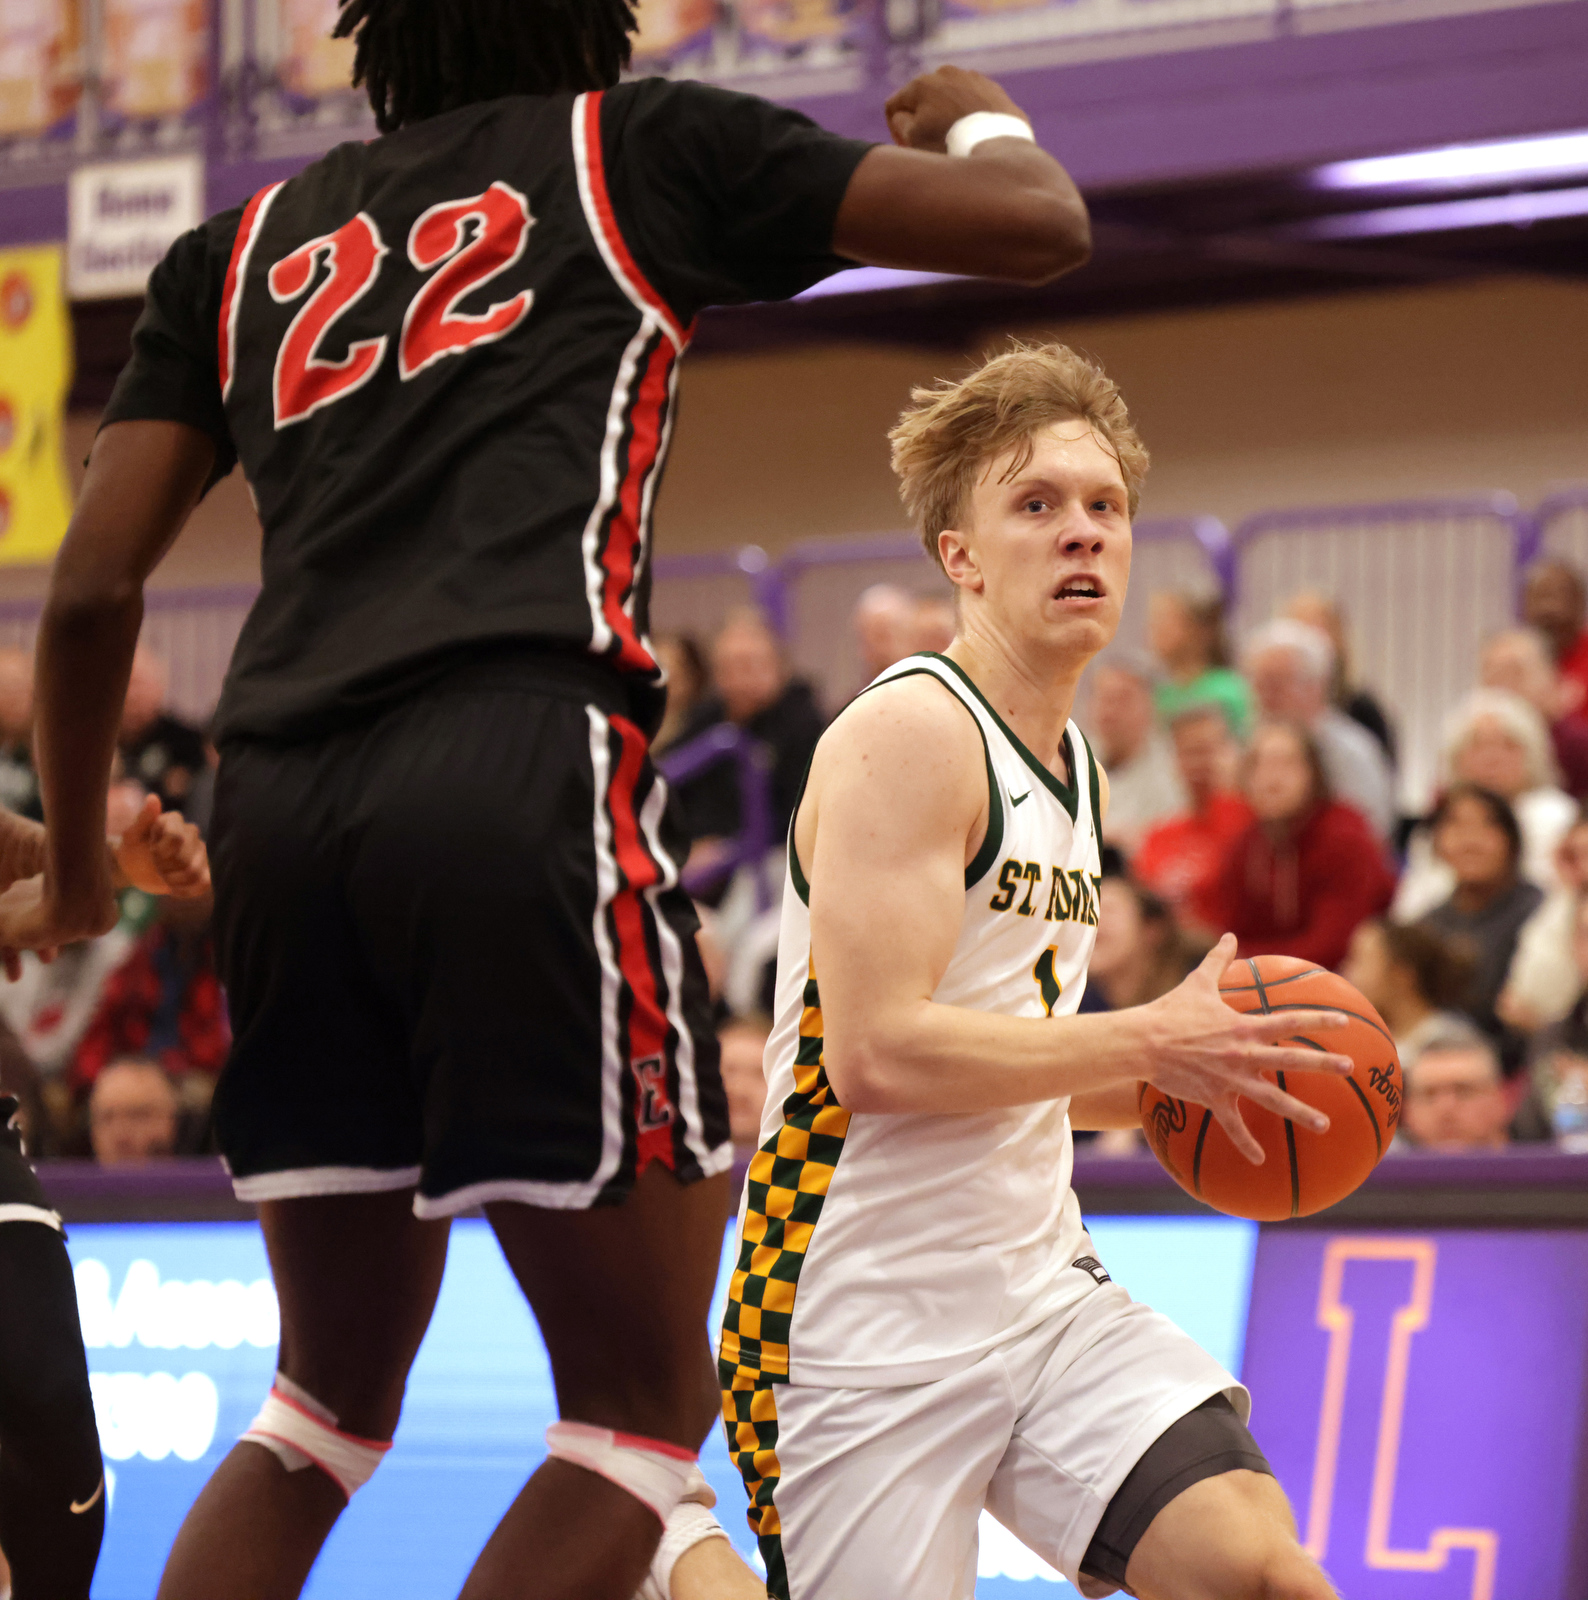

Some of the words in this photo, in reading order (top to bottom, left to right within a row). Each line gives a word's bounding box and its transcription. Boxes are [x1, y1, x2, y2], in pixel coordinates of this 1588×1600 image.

[268, 180, 537, 431] 22
[989, 858, 1043, 917] ST.
[1032, 944, 1062, 1018] 1
